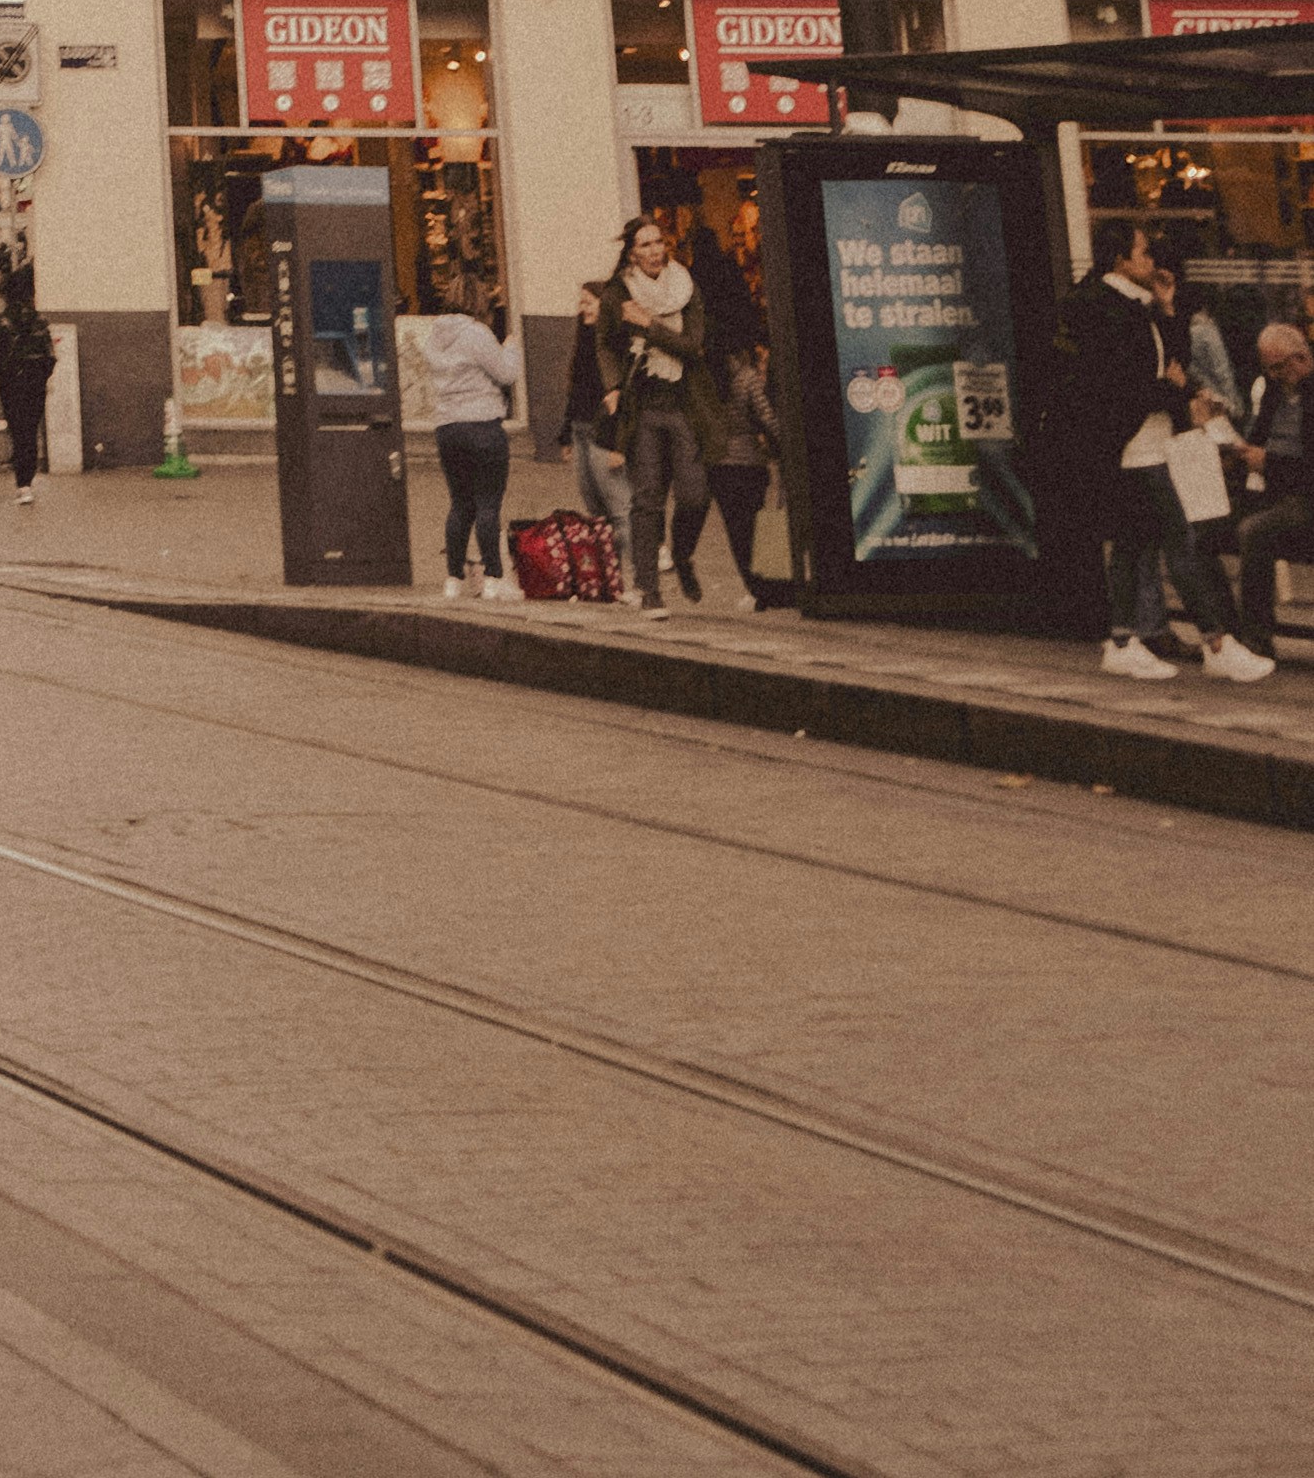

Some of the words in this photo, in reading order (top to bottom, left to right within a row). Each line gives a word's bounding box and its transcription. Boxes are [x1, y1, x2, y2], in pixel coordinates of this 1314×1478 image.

[265, 16, 387, 44] GIDEON
[715, 16, 841, 46] GIDEON
[837, 239, 883, 266] We
[889, 239, 963, 265] staan
[840, 268, 962, 297] helemaal
[843, 301, 873, 329] te
[879, 298, 979, 328] stralen.
